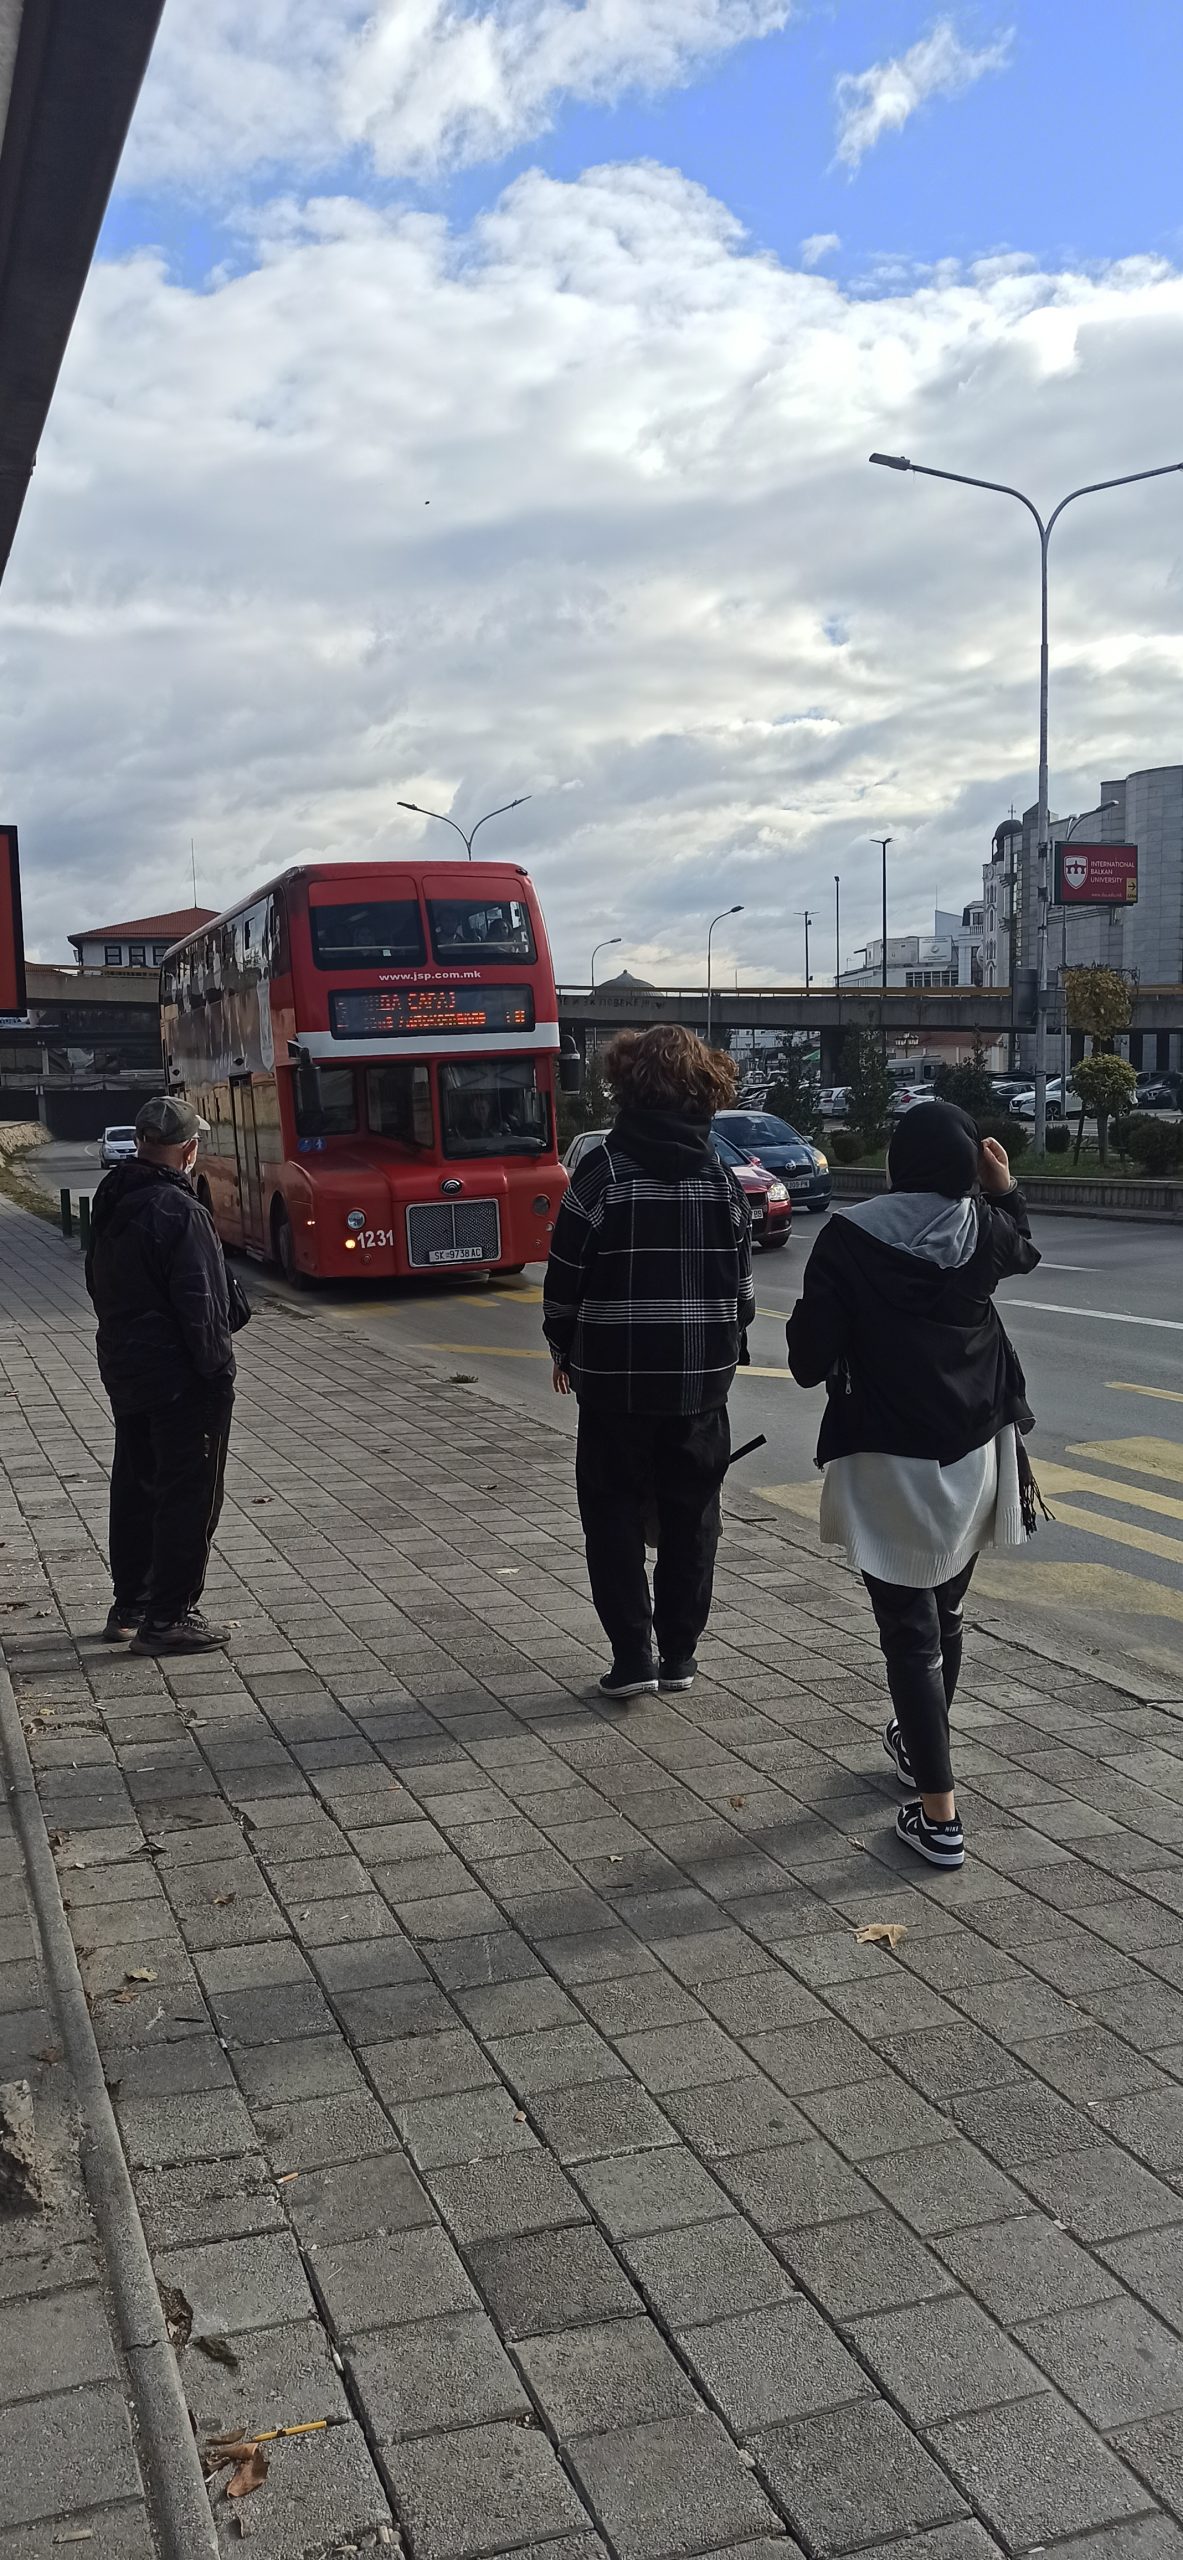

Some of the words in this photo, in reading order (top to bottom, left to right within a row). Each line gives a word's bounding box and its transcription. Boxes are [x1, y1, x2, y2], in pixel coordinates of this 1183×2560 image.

[1090, 860, 1135, 868] INTERNATIONAL
[378, 970, 482, 982] www.jsp.com.mk
[356, 1228, 395, 1249] 1231
[434, 1250, 445, 1260] SK
[449, 1248, 470, 1259] 9738
[471, 1247, 481, 1257] AC
[944, 1825, 959, 1833] NIKE
